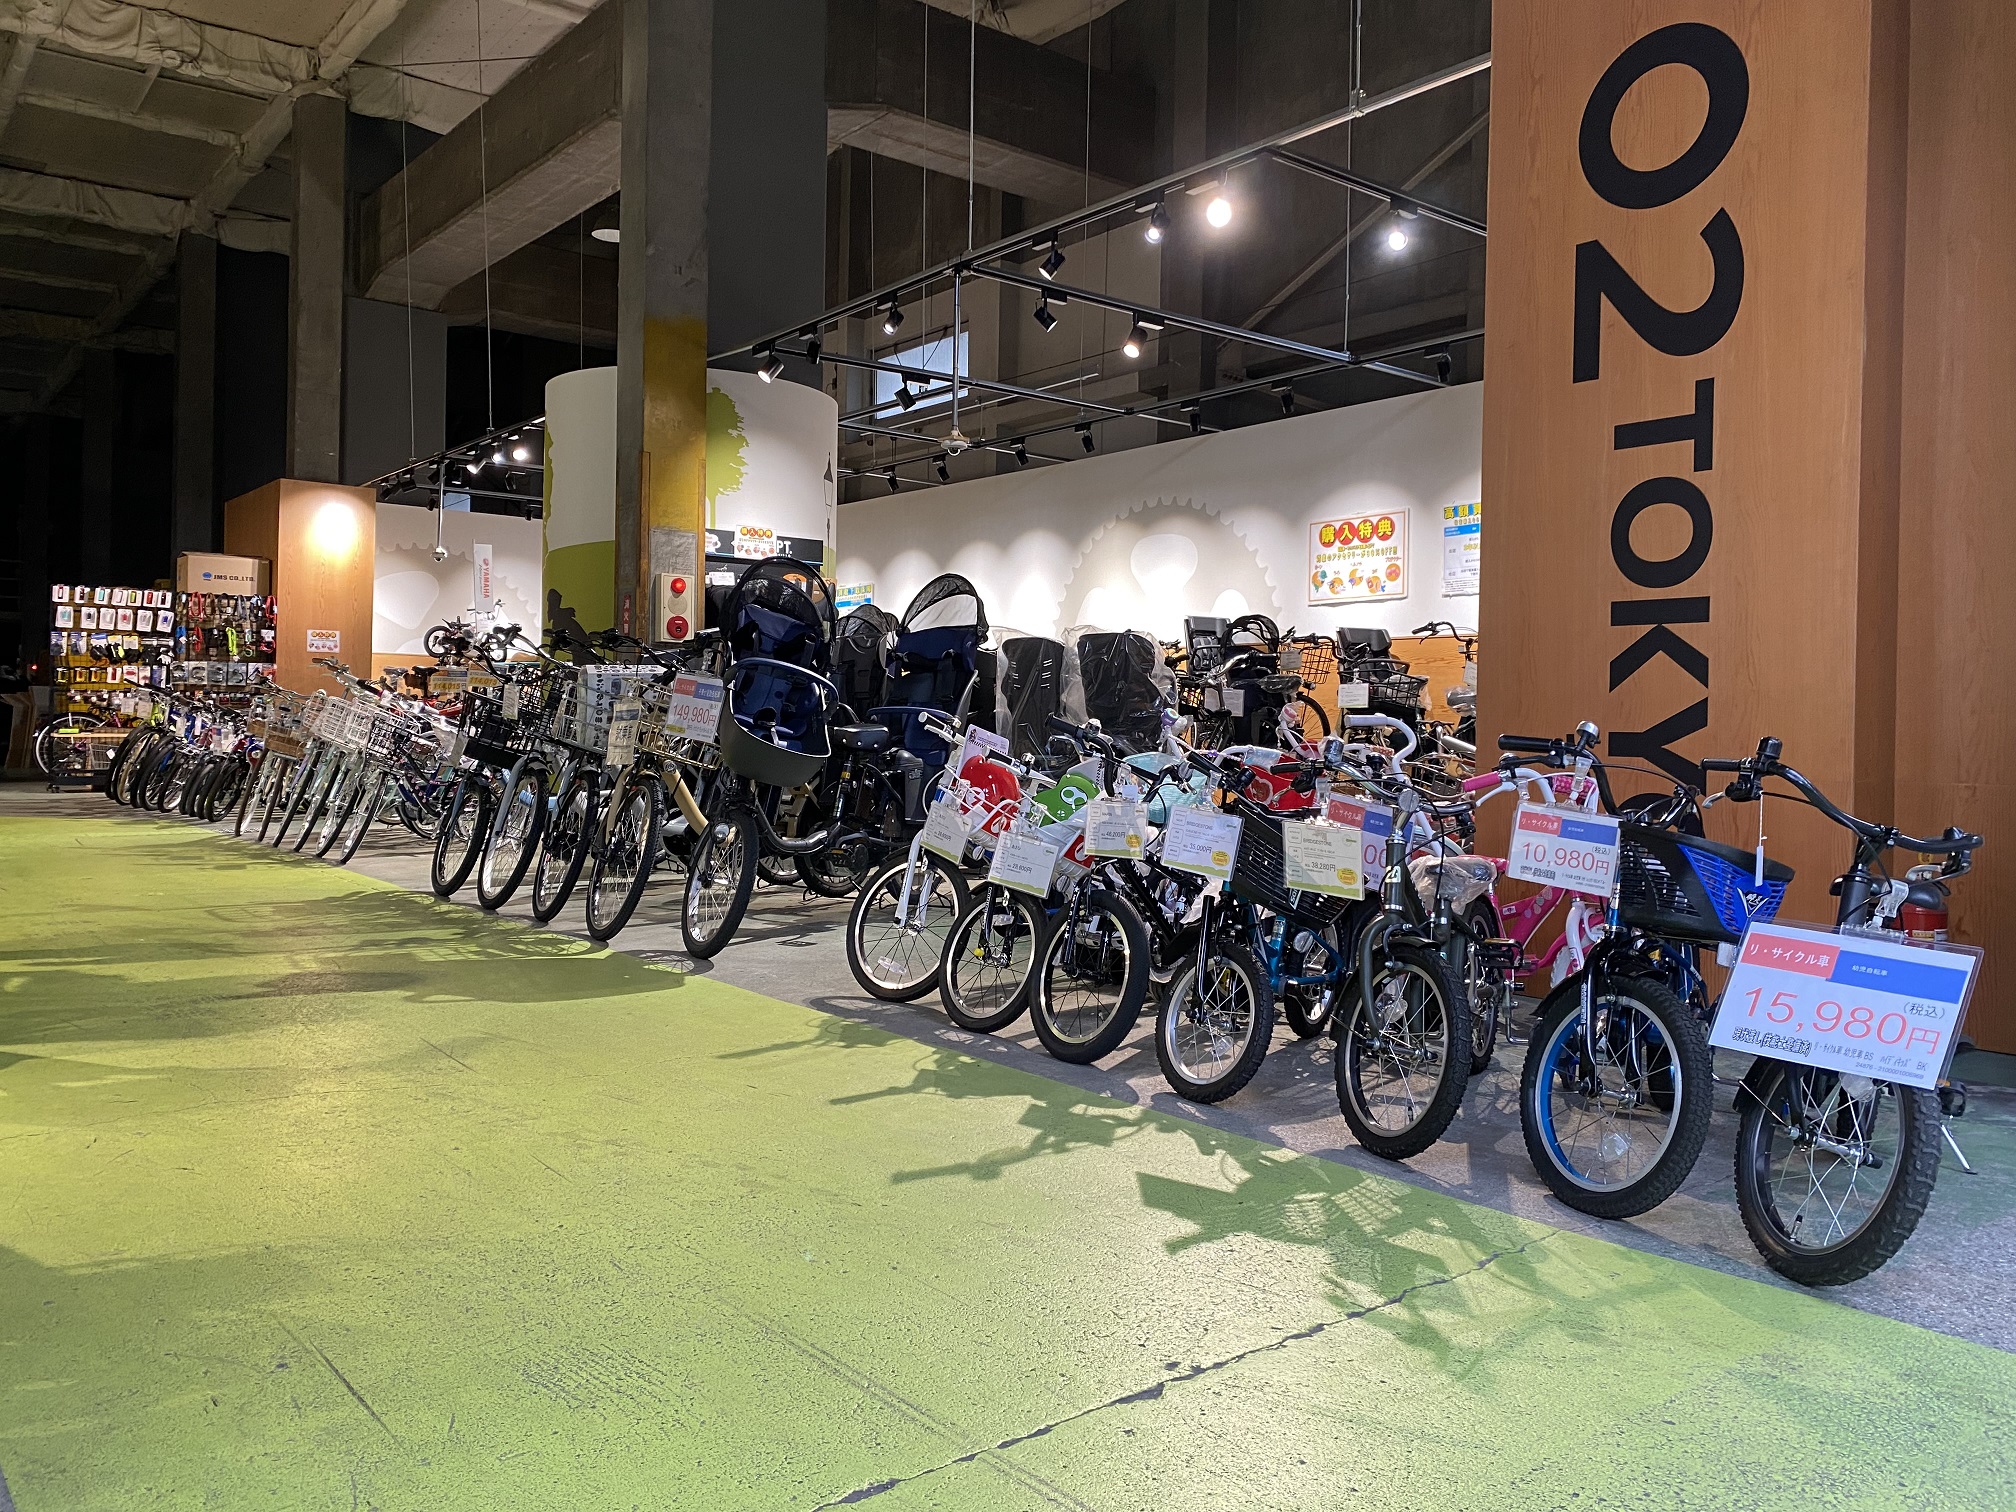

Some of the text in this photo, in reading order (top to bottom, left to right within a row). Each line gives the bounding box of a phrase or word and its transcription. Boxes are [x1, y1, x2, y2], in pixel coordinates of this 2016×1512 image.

[1321, 519, 1393, 544] 購入特典
[673, 703, 717, 727] 149,980円
[1521, 817, 1559, 830] リ・サイクル車
[1522, 842, 1610, 876] 10,980円
[1750, 942, 1830, 968] リ・サイクル車
[1852, 964, 1889, 977] 幼児自転車
[1744, 986, 1942, 1055] 15,980円
